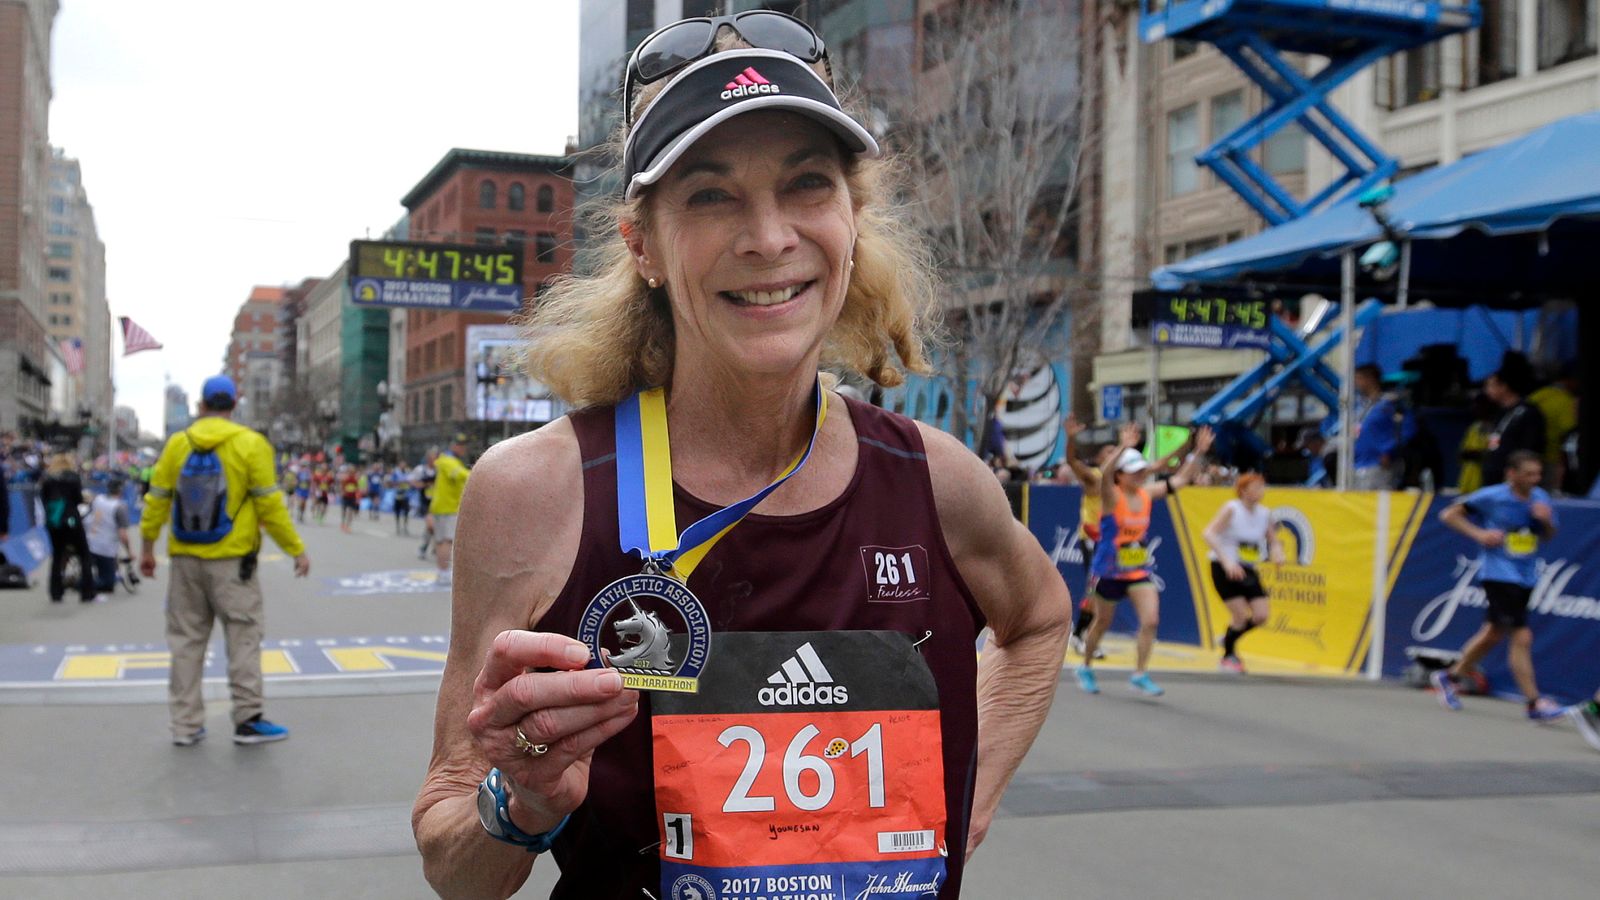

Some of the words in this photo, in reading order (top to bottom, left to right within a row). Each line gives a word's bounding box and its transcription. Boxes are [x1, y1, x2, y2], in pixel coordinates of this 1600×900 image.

[720, 82, 780, 100] adidas
[383, 249, 515, 285] 4:47:45
[382, 290, 451, 305] MARATHON
[1170, 298, 1266, 330] 4:47:45
[874, 551, 916, 585] 261
[877, 585, 921, 599] Fearless
[599, 578, 663, 610] ATHLETIC
[663, 584, 705, 670] ASSOCIATION
[633, 658, 650, 669] 2017
[622, 676, 641, 687] TON
[641, 677, 694, 690] MARATHON
[757, 681, 849, 706] adidas
[716, 722, 886, 813] 261
[667, 817, 685, 856] 1
[721, 878, 761, 894] 2017
[766, 875, 832, 893] BOSTON
[890, 870, 941, 897] Hancock
